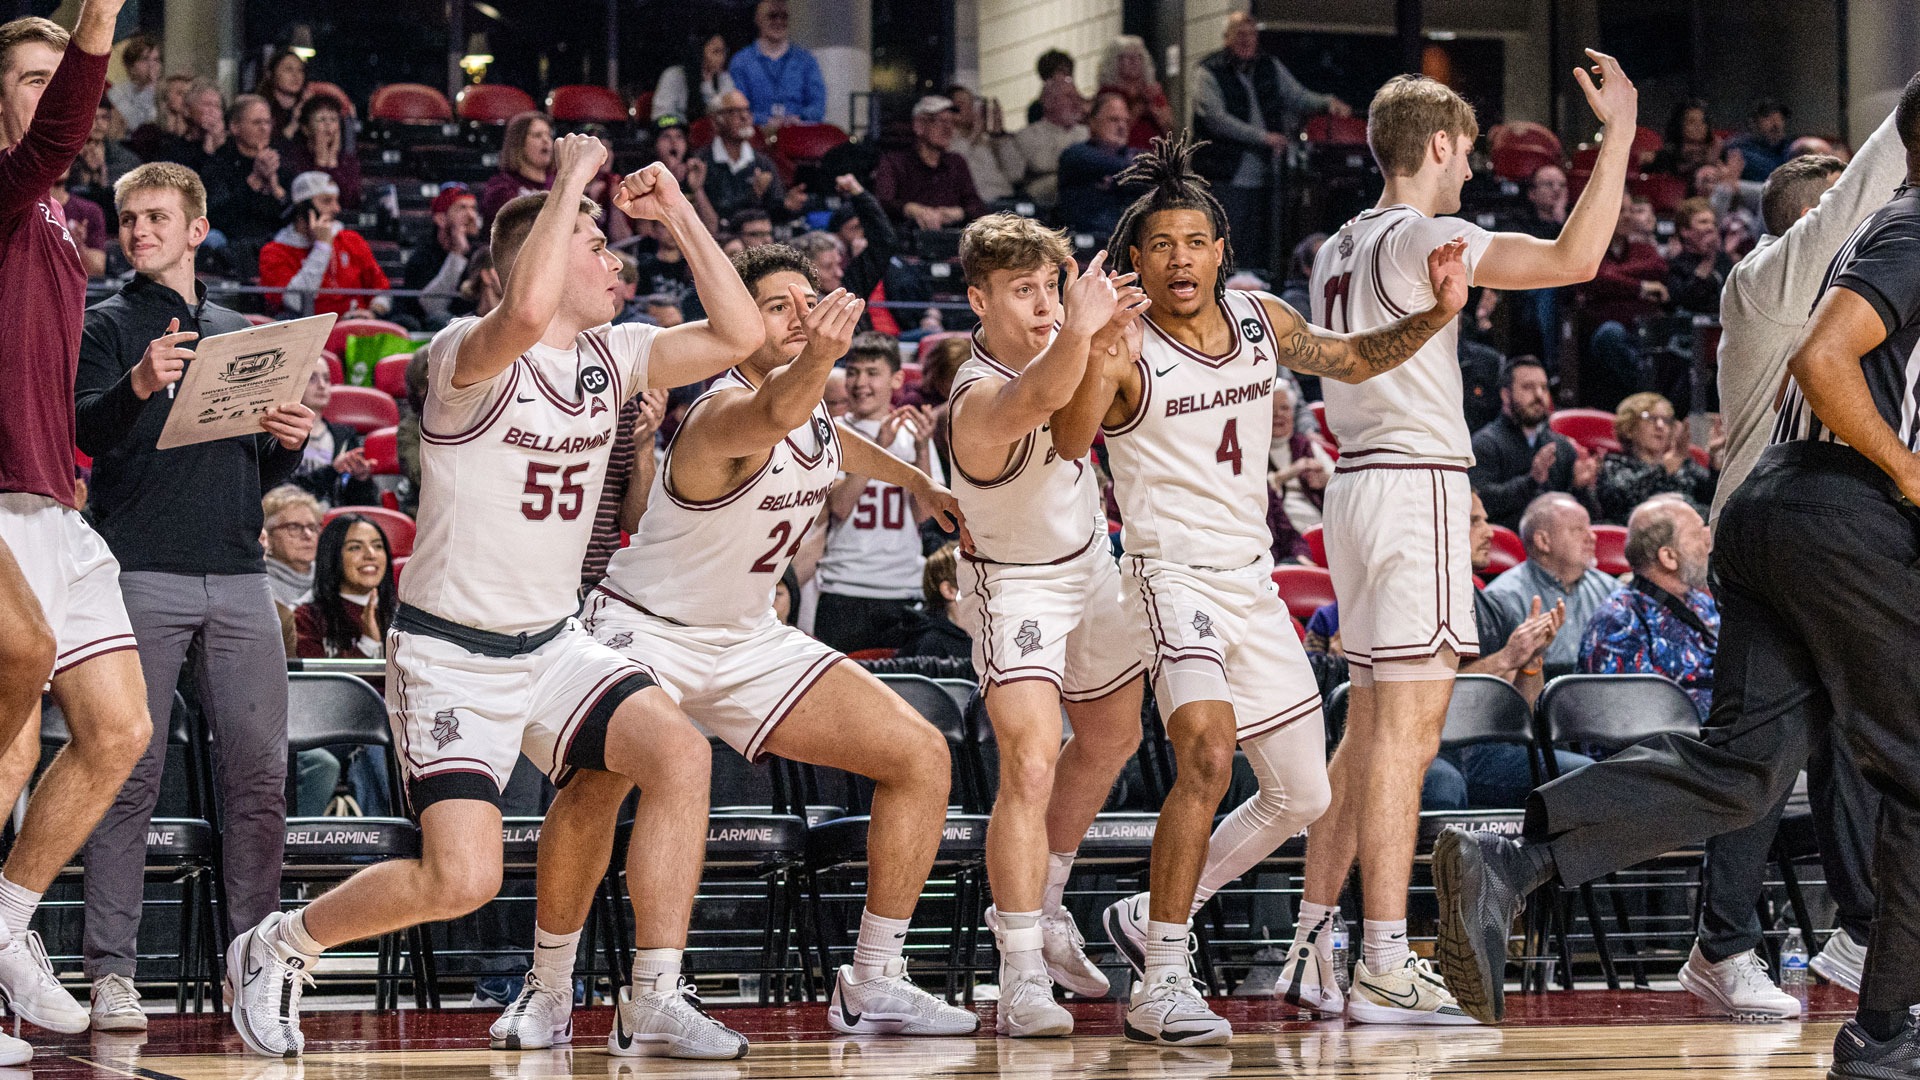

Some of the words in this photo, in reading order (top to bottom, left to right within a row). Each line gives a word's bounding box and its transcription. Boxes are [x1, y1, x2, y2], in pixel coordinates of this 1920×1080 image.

[1243, 322, 1261, 339] CG
[229, 381, 263, 390] SPORTING
[264, 375, 289, 383] GOODS
[583, 371, 605, 390] CG
[1164, 377, 1272, 418] BELLARMINE
[502, 427, 612, 454] BELLARMINE
[1216, 416, 1243, 477] 4
[520, 460, 590, 522] 55
[286, 831, 380, 845] BELLARMINE
